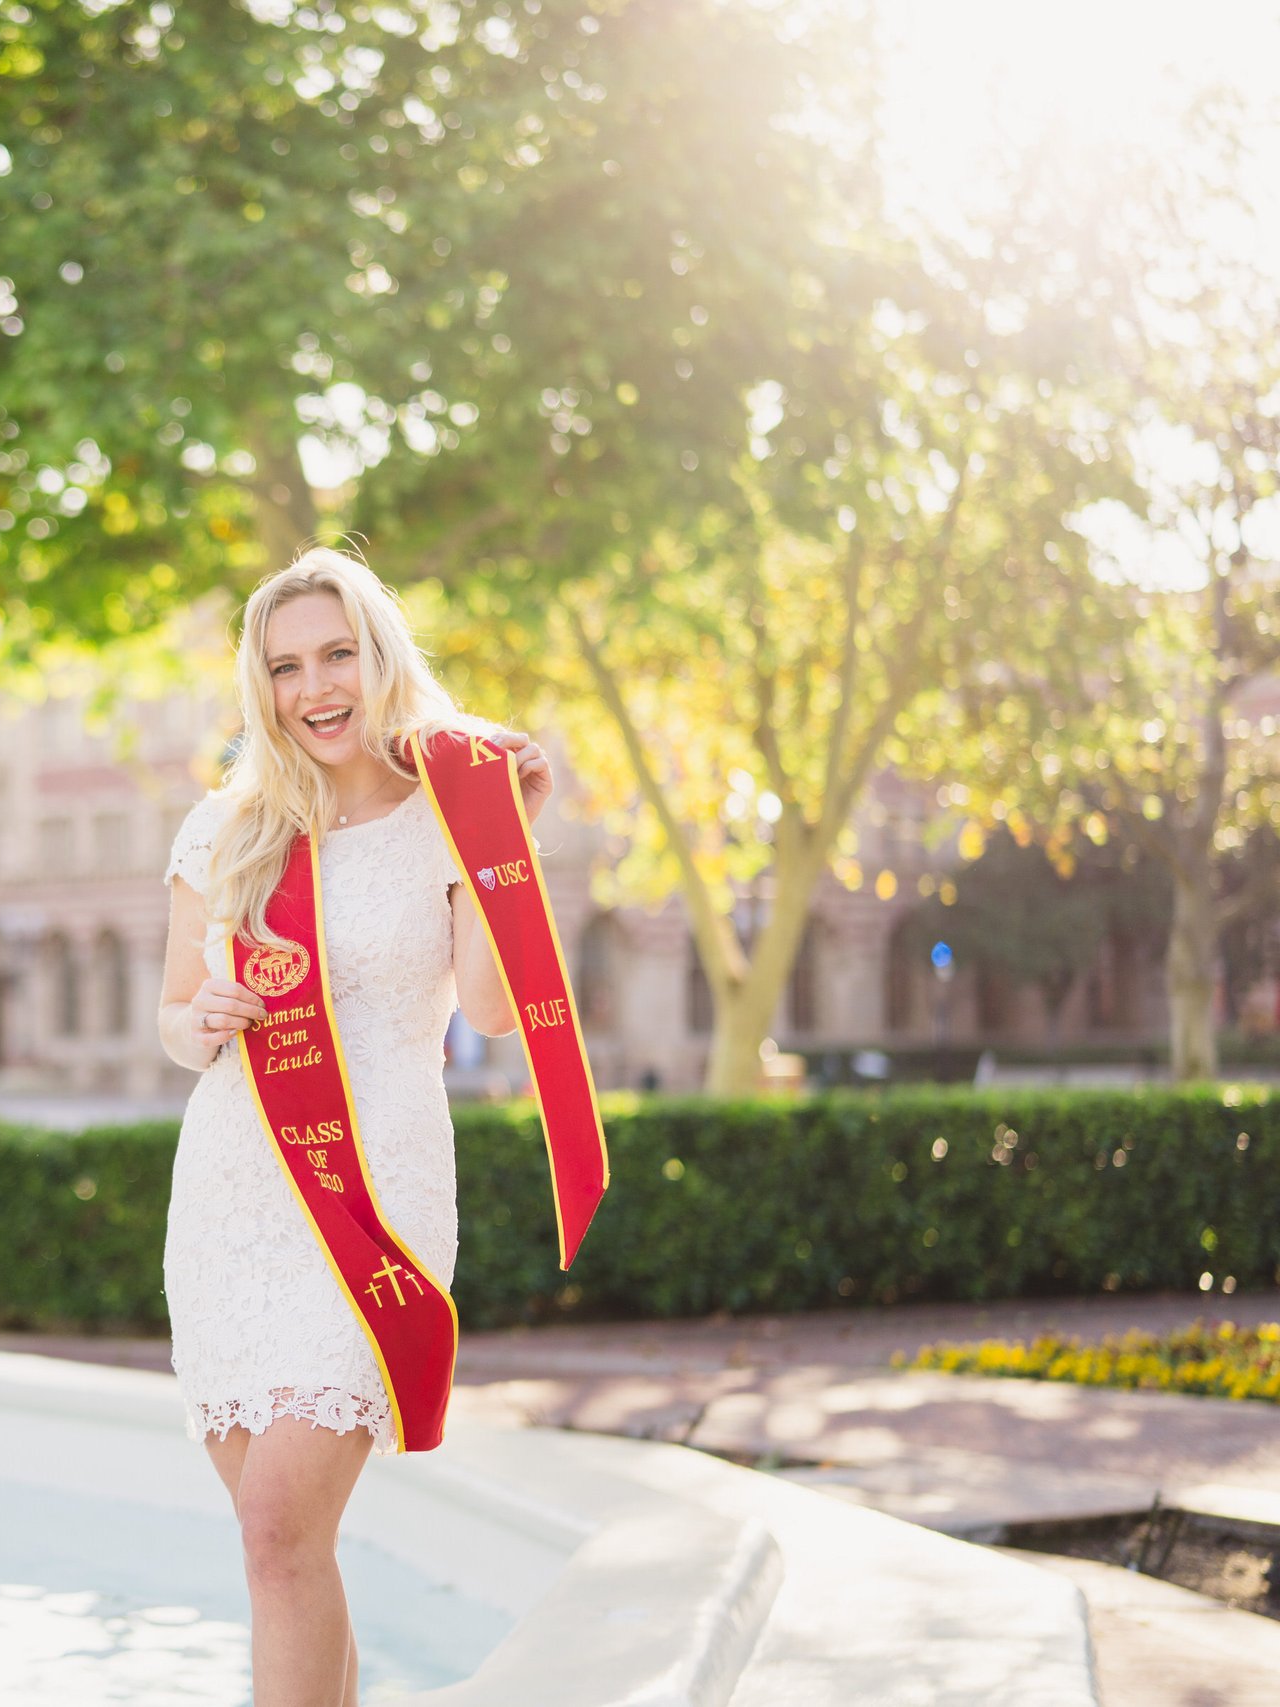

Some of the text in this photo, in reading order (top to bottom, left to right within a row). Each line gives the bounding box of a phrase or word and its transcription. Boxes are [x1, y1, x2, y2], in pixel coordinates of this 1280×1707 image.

[470, 735, 502, 767] K
[495, 859, 529, 887] USC
[524, 999, 567, 1032] RUF
[268, 1029, 309, 1051] Cum
[264, 1045, 323, 1074] Laude
[280, 1120, 344, 1145] CLASS
[306, 1149, 328, 1169] OF
[313, 1170, 344, 1193] 2020
